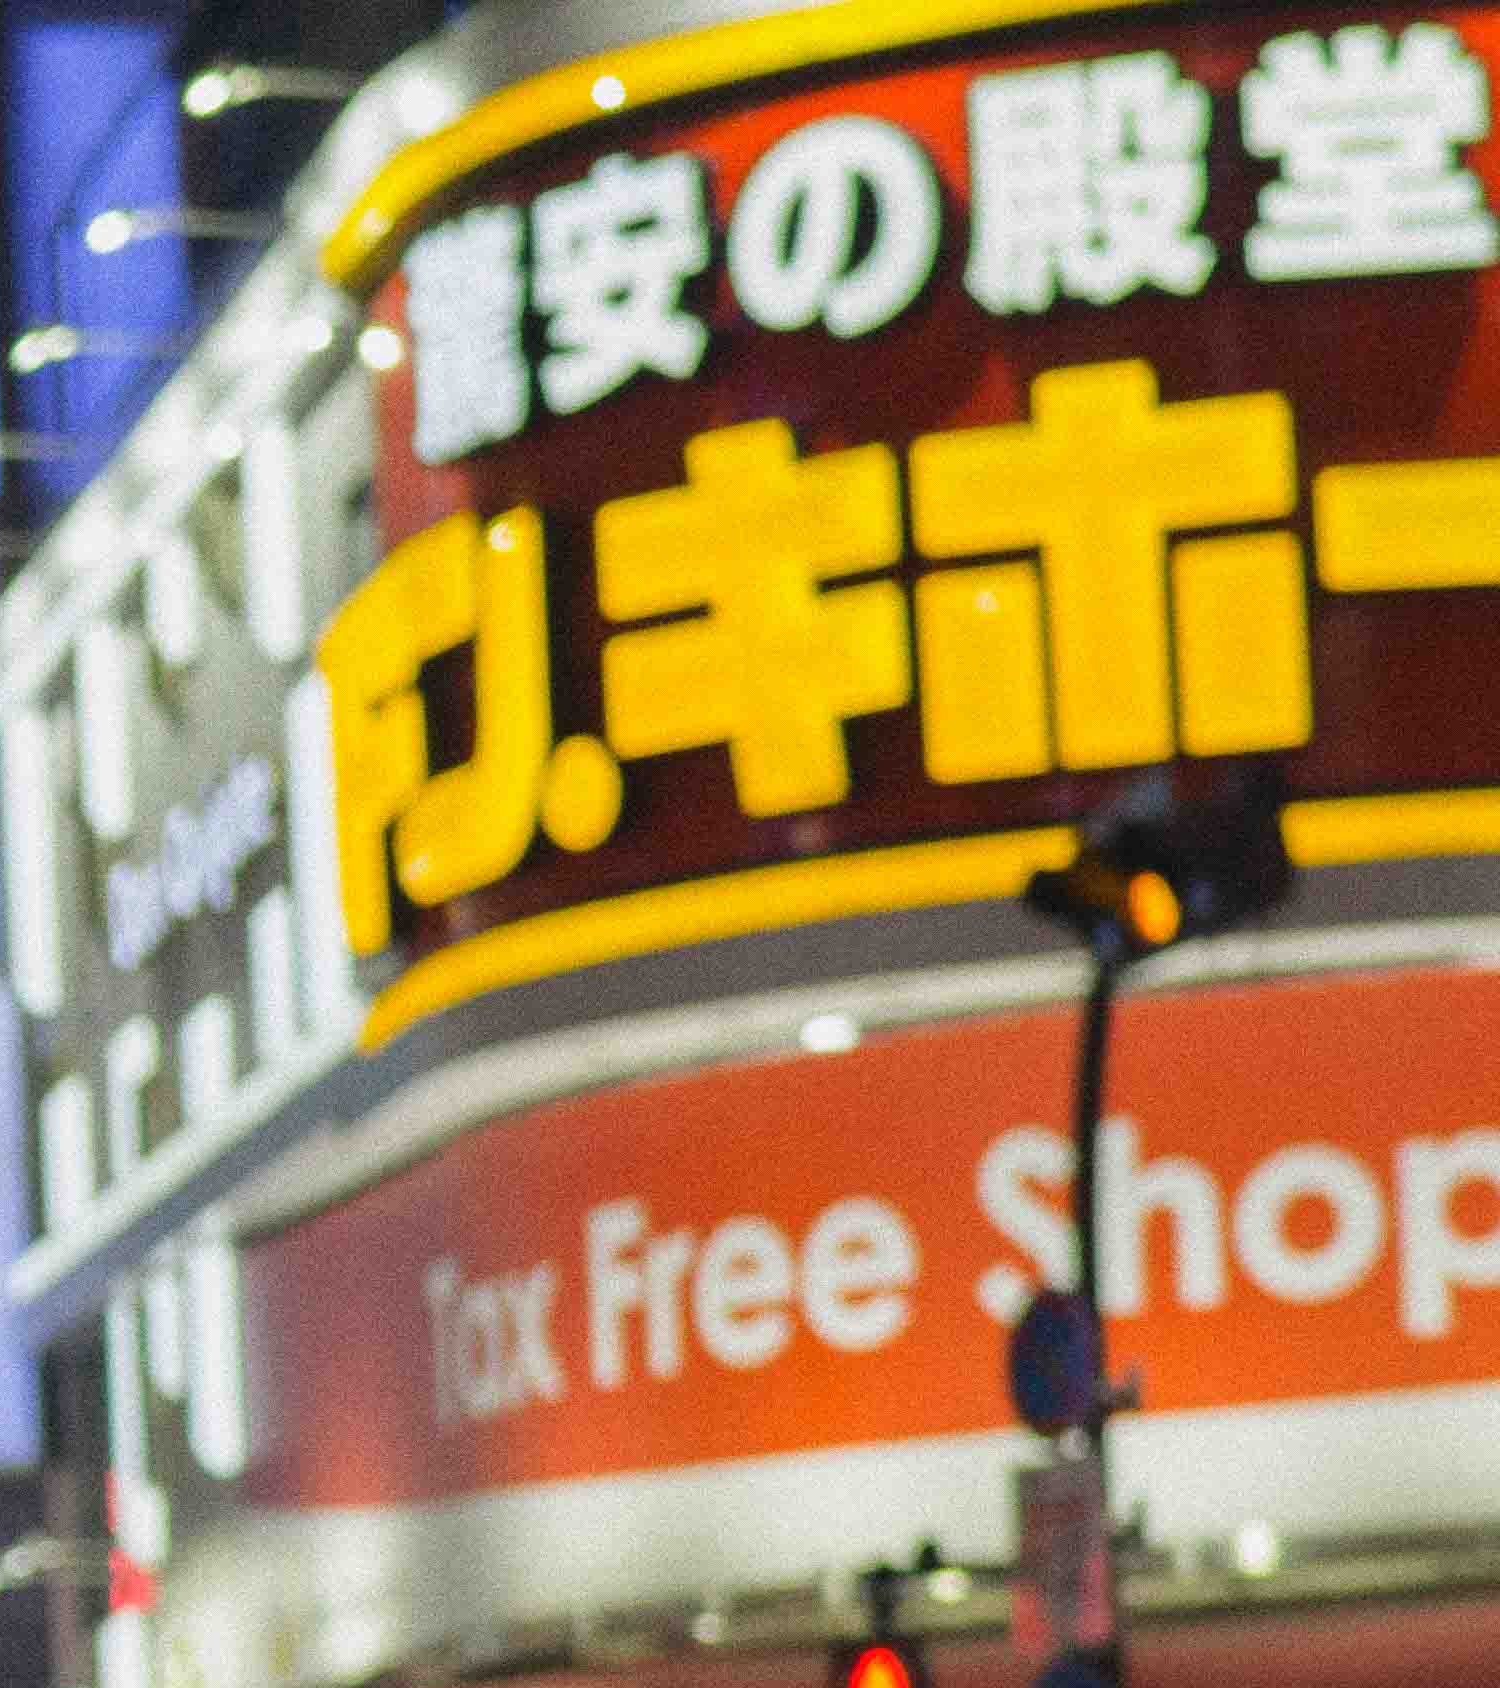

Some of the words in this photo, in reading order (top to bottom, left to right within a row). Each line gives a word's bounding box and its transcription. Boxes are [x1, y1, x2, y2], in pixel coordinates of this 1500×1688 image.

[405, 20, 1498, 468] 驚安の殿堂
[425, 1262, 568, 1420] Tax
[584, 1192, 918, 1390] Free
[974, 1115, 1500, 1342] Shop
